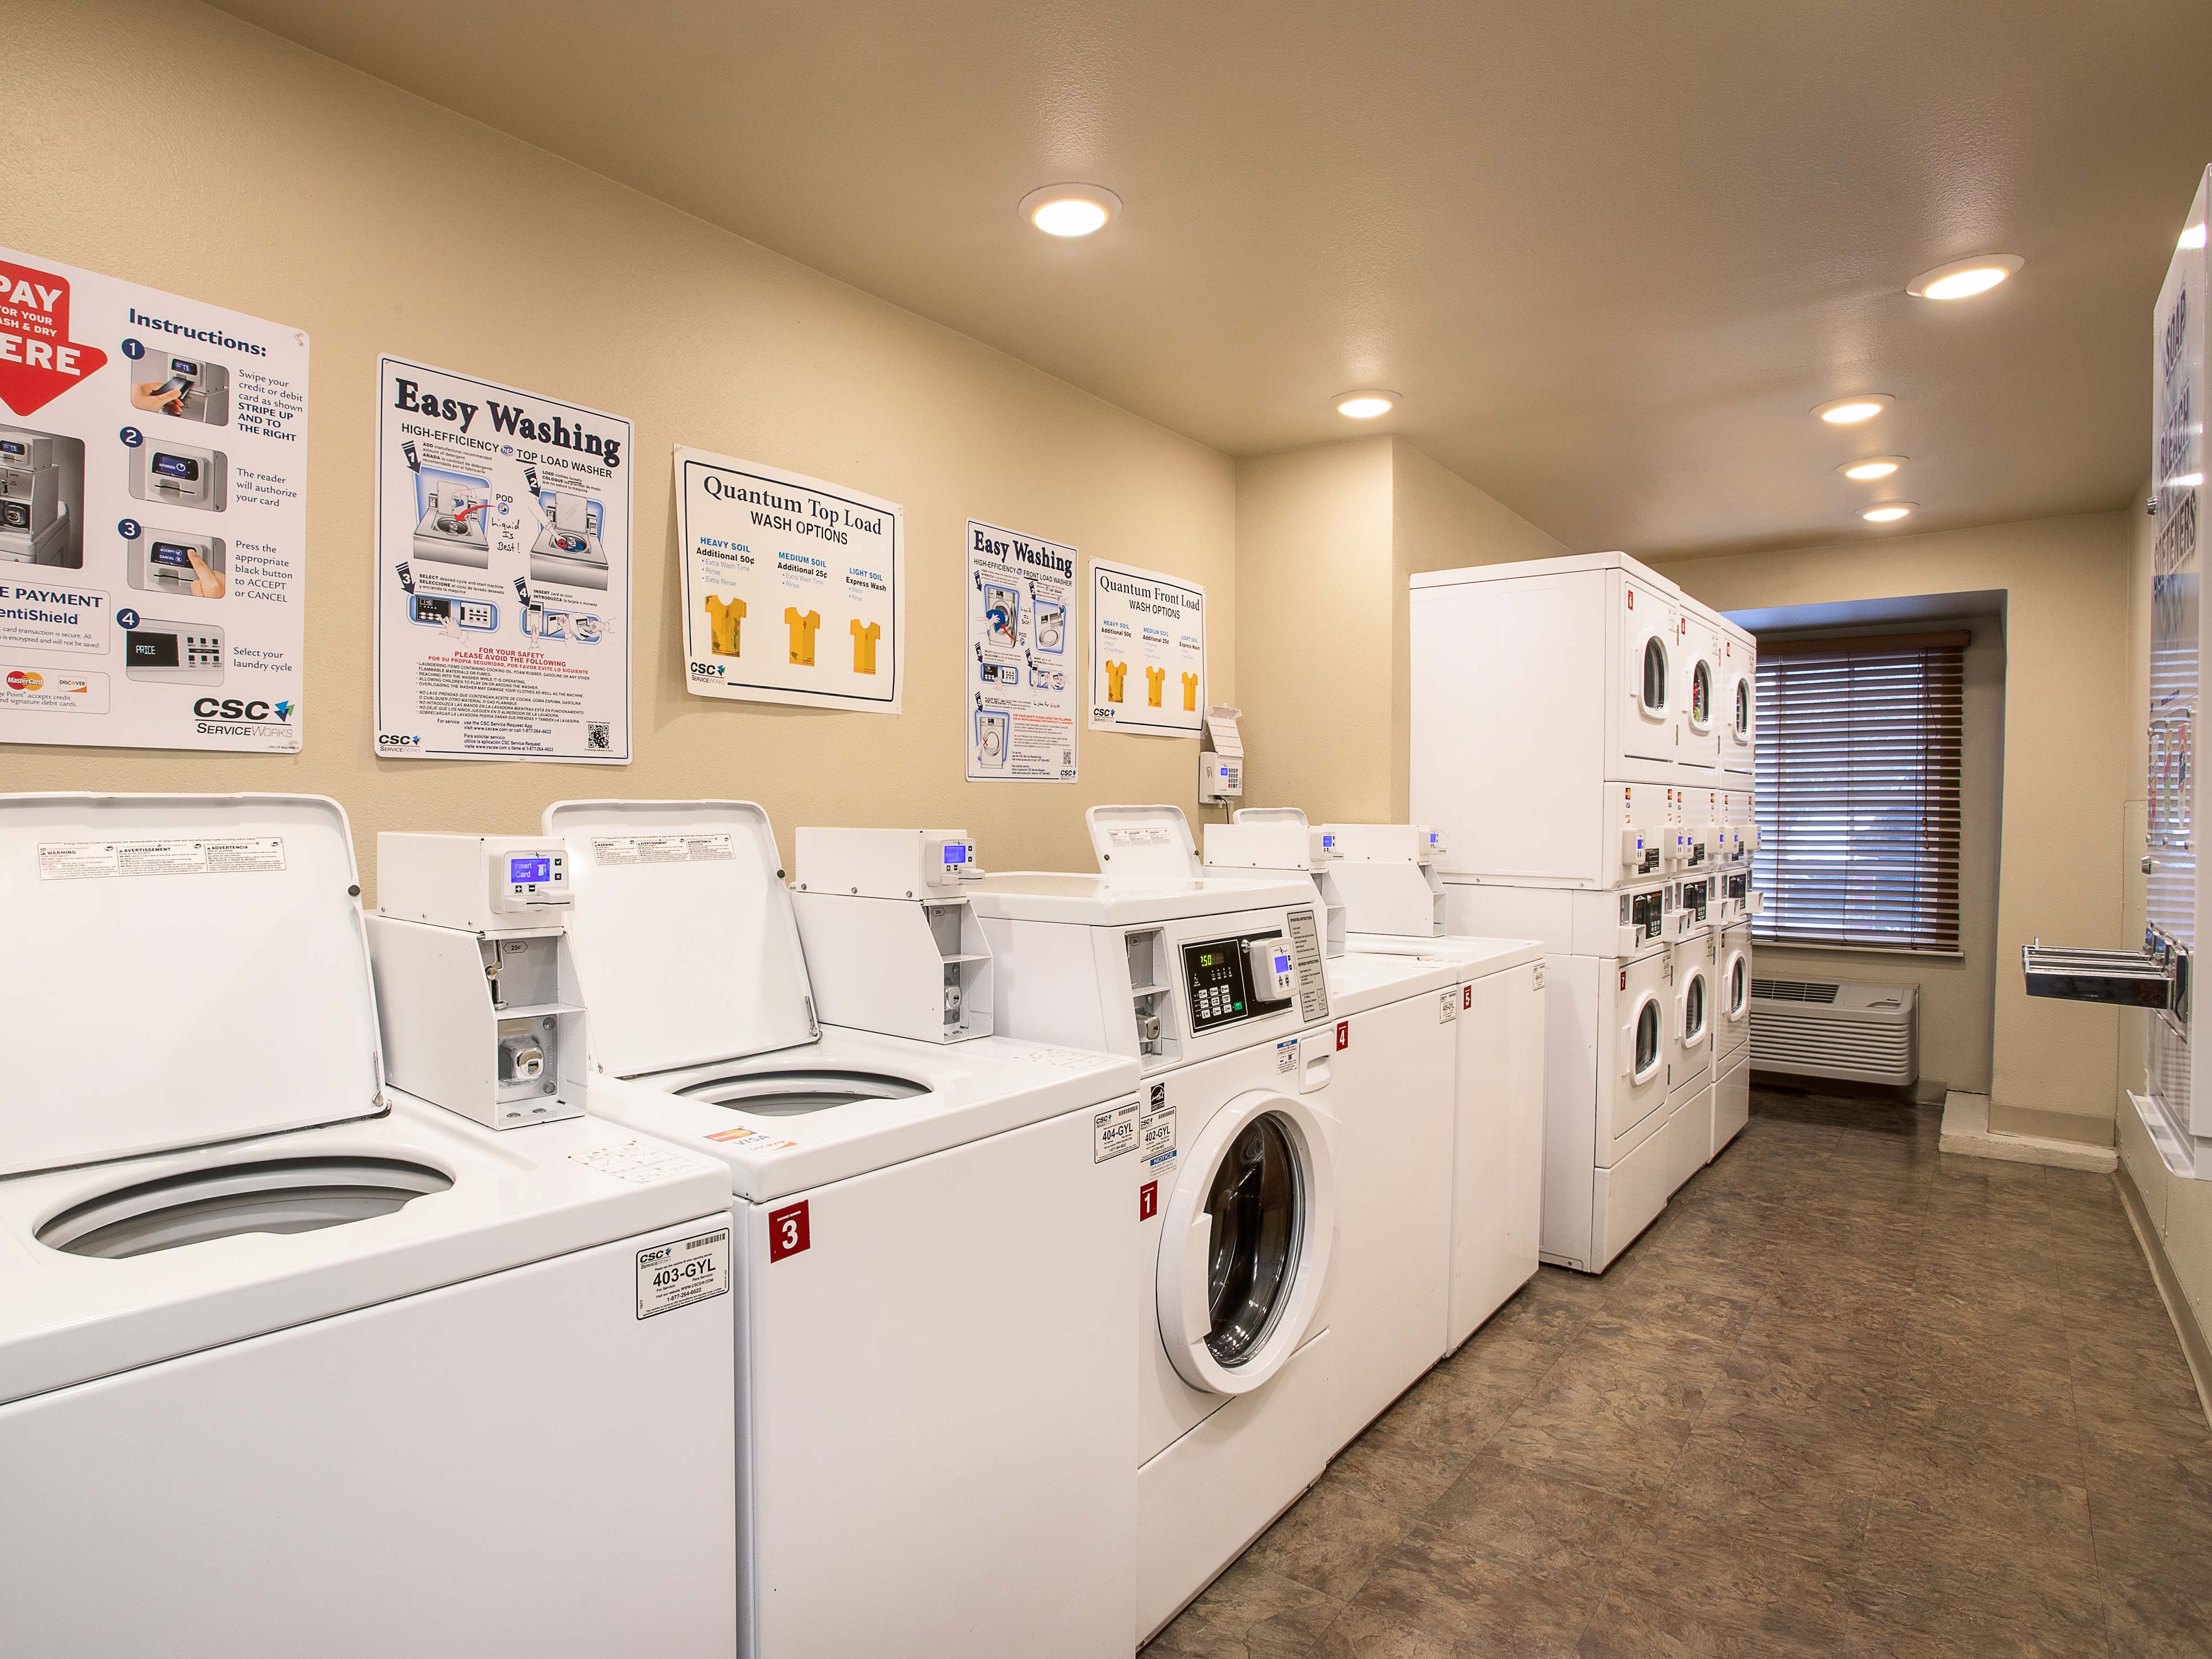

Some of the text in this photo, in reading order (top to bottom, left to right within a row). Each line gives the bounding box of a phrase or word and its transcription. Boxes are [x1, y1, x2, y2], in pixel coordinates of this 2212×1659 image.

[22, 311, 53, 325] YOUR
[34, 325, 57, 337] DRY
[130, 308, 267, 357] Instructions:
[2166, 283, 2185, 383] SOAP
[0, 332, 80, 376] ERE
[129, 343, 135, 356] 1
[239, 369, 289, 388] Swipe your
[239, 382, 265, 393] credit
[280, 390, 302, 401] debit
[239, 393, 259, 403] card
[274, 400, 302, 412] shown
[238, 403, 293, 420] STRIPE UP
[238, 414, 280, 427] AND TO
[395, 378, 620, 468] Easy Washing
[124, 429, 137, 444] 2
[238, 423, 296, 441] THE RIGHT
[402, 423, 499, 452] HIGH-EFFICIENCY
[2161, 380, 2189, 487] BLEACH
[409, 452, 414, 462] 1
[517, 449, 612, 478] TOP LOAD WASHER
[237, 468, 286, 484] The reader
[530, 478, 537, 487] 2
[237, 481, 297, 498] will authorize
[236, 493, 279, 507] your card
[497, 494, 513, 503] POD
[704, 476, 881, 535] Quantum Top Load
[124, 522, 135, 536] 3
[492, 517, 520, 530] Liquid
[750, 511, 847, 545] WASH OPTIONS
[236, 540, 276, 553] Press the
[701, 537, 750, 552] HEAVY SOIL
[2154, 488, 2196, 595] SOFTENERS
[236, 555, 289, 567] appropriate
[697, 547, 754, 565] Additional 50¢
[779, 552, 826, 567] MEDIUM SOIL
[974, 530, 1009, 564] Easy
[1013, 540, 1072, 578] Washing
[236, 565, 292, 579] black button
[778, 562, 827, 578] Additional 25¢
[974, 559, 1016, 573] HIGH-EFFICIENCY
[403, 573, 411, 584] 3
[850, 568, 883, 581] LIGHT SOIL
[1024, 570, 1039, 578] FRONT
[1053, 577, 1072, 587] WASHER
[248, 579, 286, 590] ACCEPT
[846, 577, 886, 591] Express Wash
[16, 588, 103, 608] PAYMENT
[248, 590, 288, 602] CANCEL
[520, 588, 527, 597] 4
[1100, 576, 1199, 611] Quantum Front Load
[1629, 596, 1632, 607] 6
[0, 608, 78, 624] entiShield
[1129, 600, 1180, 619] WASH OPTIONS
[122, 612, 134, 625] 4
[136, 645, 155, 655] PRICE
[234, 647, 283, 660] Select your
[234, 659, 292, 671] laundry cycle
[526, 658, 566, 667] FOLLOWING
[691, 662, 716, 675] CSC
[7, 677, 43, 685] MasterCard
[194, 698, 269, 720] CSC
[379, 734, 410, 745] CSC
[1622, 976, 1624, 987] 7
[1465, 992, 1470, 1006] 5
[1340, 1030, 1345, 1045] 4
[1096, 1115, 1108, 1124] CSC
[1103, 1123, 1133, 1141] 404-GYL
[1145, 1125, 1170, 1142] 402-GYL
[733, 1135, 770, 1145] VISA
[1154, 1152, 1173, 1164] NOTICE
[1144, 1193, 1151, 1213] 1
[782, 1219, 798, 1249] 3
[640, 1250, 664, 1263] CSC
[653, 1258, 716, 1287] 403-GYL
[681, 1278, 713, 1291] WWW.CSCSW.COM
[667, 1287, 702, 1302] 1-877-264-6622
